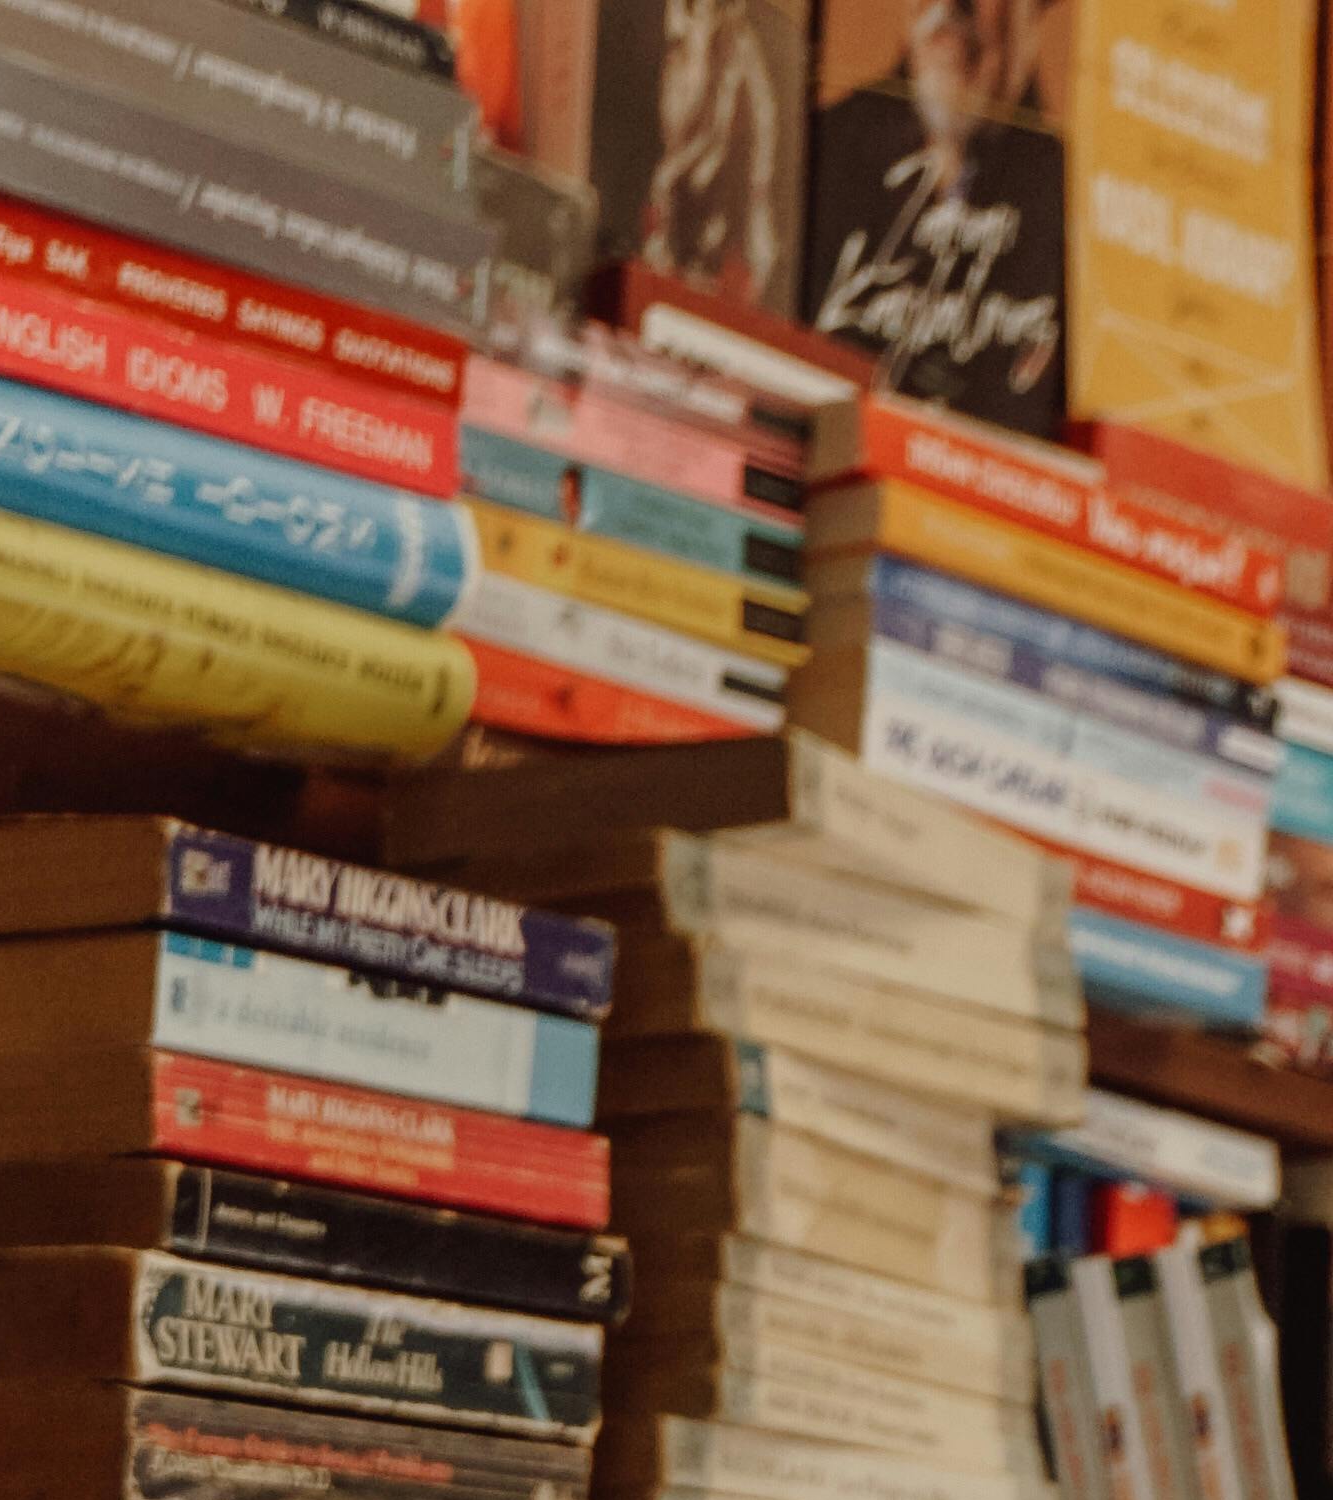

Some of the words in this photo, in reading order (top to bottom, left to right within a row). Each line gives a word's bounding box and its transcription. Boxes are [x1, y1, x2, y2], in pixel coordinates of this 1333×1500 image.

[125, 346, 229, 414] IDIOMS
[298, 395, 434, 473] FREEMAN
[252, 843, 337, 908] MARY
[333, 859, 436, 932] HIGGINS
[434, 888, 528, 961] CLARK
[182, 1276, 274, 1329] MARY
[363, 1317, 407, 1347] The
[154, 1319, 307, 1380] STEWART
